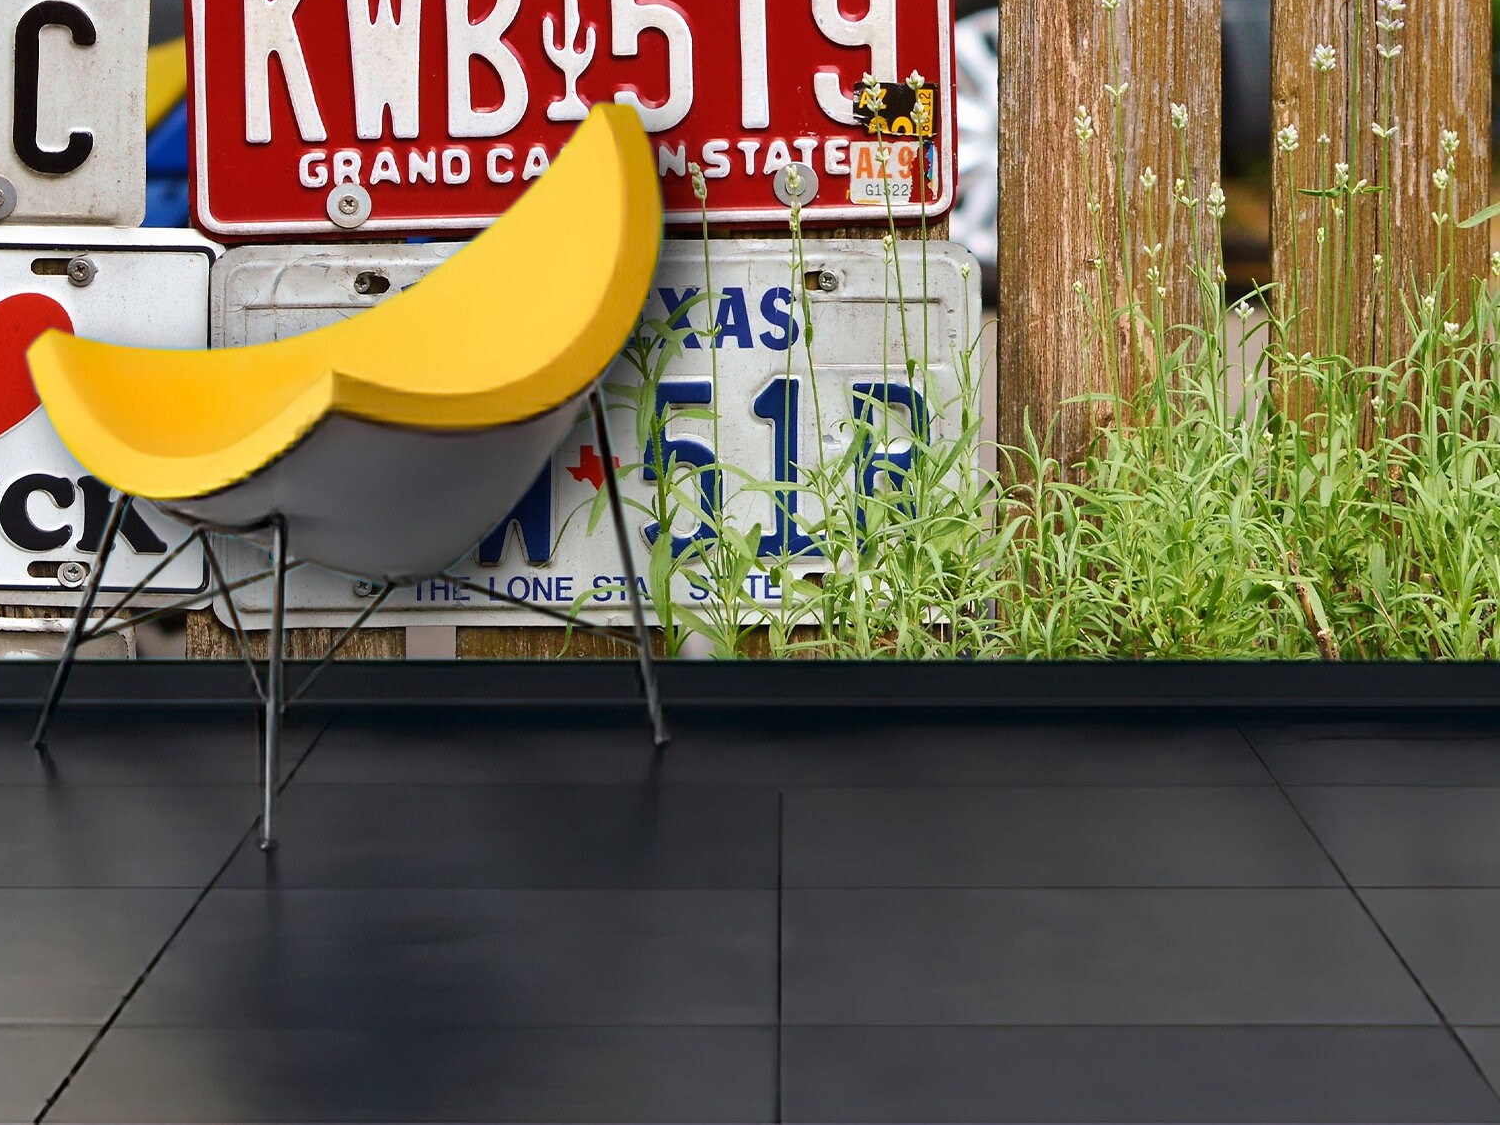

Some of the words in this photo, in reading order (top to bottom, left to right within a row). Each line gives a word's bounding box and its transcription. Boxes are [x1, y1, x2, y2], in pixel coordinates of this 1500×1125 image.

[300, 150, 471, 188] GRAND
[486, 145, 687, 182] CAN
[703, 138, 851, 177] STATE
[856, 146, 893, 179] AZ
[865, 184, 911, 196] G1522
[626, 286, 800, 351] XAS
[489, 576, 574, 602] LONE
